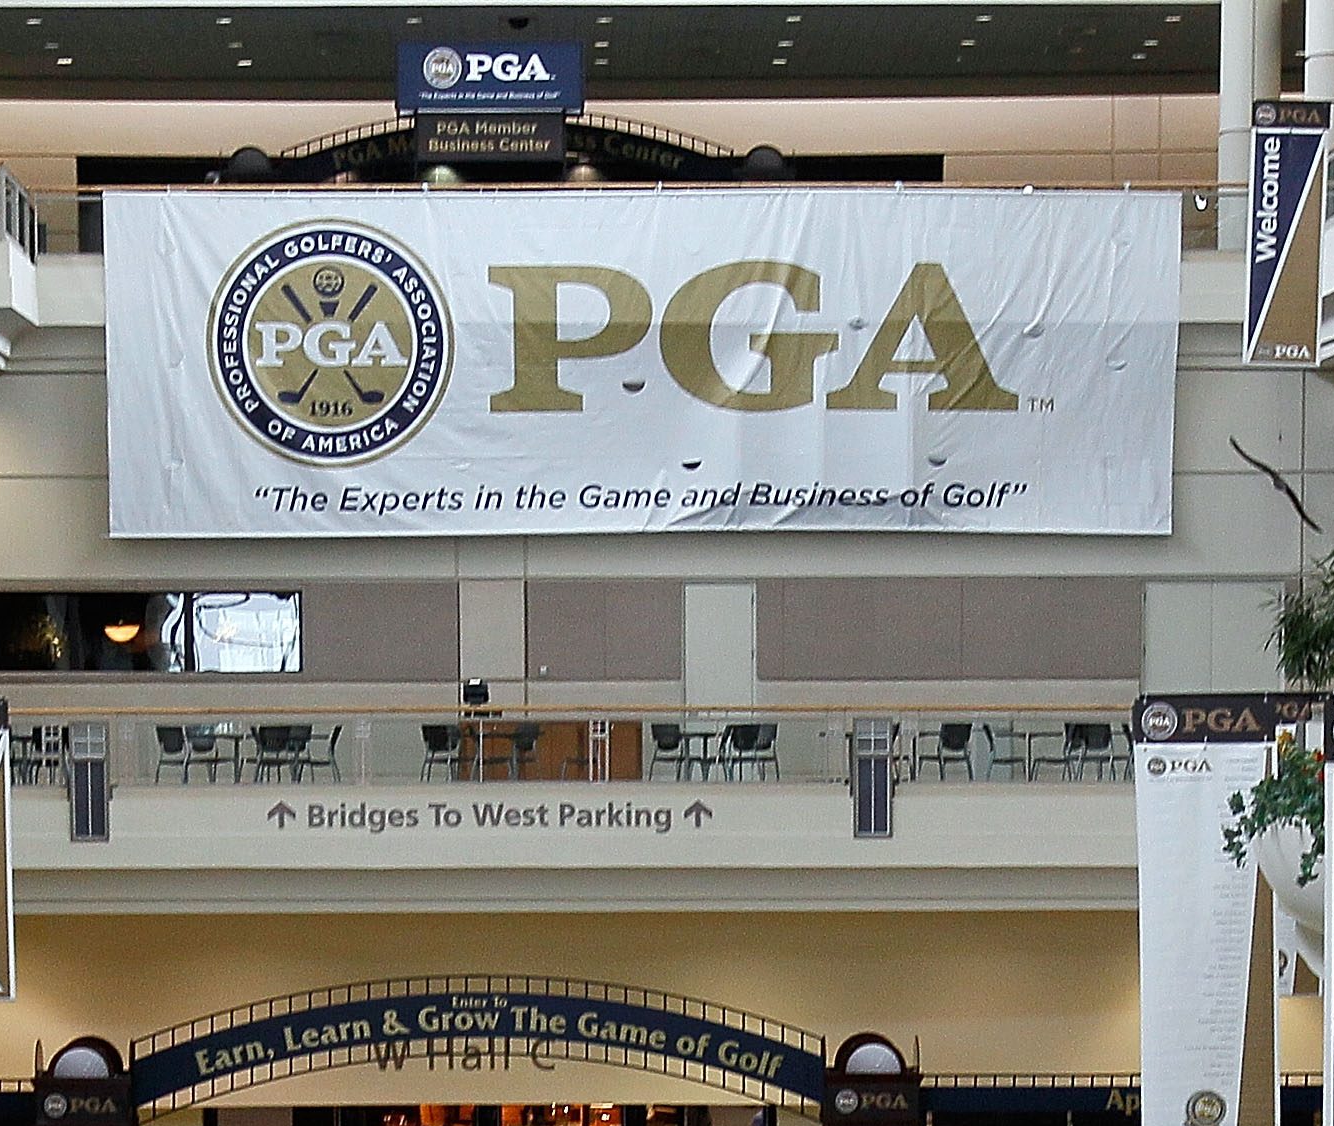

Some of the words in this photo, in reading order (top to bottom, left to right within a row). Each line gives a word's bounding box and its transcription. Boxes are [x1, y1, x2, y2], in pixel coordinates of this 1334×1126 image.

[466, 54, 551, 81] PGA
[436, 121, 469, 135] PGA
[476, 120, 538, 135] Member
[1279, 106, 1323, 122] PGA
[428, 137, 495, 152] Business
[500, 137, 550, 152] Center
[1254, 135, 1281, 264] Welcome
[222, 253, 281, 415] PROFESSIONAL
[392, 266, 438, 415] ASSOCIATION
[254, 319, 409, 369] PGA
[488, 260, 1019, 413] PGA
[1275, 346, 1312, 360] PGA
[308, 400, 354, 417] 1916
[1029, 397, 1054, 412] TM
[267, 419, 296, 442] OF
[300, 416, 400, 454] AMERICA
[338, 485, 464, 517] Experts
[474, 483, 504, 512] in
[514, 484, 567, 512] the
[578, 483, 671, 511] Game
[681, 482, 742, 508] and
[748, 481, 889, 508] Business
[899, 481, 936, 510] of
[1181, 706, 1263, 734] PGA
[1170, 758, 1213, 773] PGA
[307, 802, 419, 834] Bridges
[428, 803, 462, 828] To
[471, 802, 549, 828] West
[558, 802, 673, 833] Parking
[452, 995, 488, 1009] Enter
[194, 1037, 276, 1076] Earn,
[282, 1017, 372, 1051] Learn
[382, 1008, 411, 1036] &
[418, 1004, 501, 1033] Grow
[510, 1005, 567, 1036] The
[577, 1011, 667, 1049] Game
[675, 1032, 713, 1059] of
[718, 1039, 785, 1079] Golf
[373, 1038, 410, 1072] W
[427, 1035, 510, 1072] Hall
[530, 1037, 555, 1071] C
[69, 1097, 117, 1114] PGA
[860, 1093, 909, 1110] PGA
